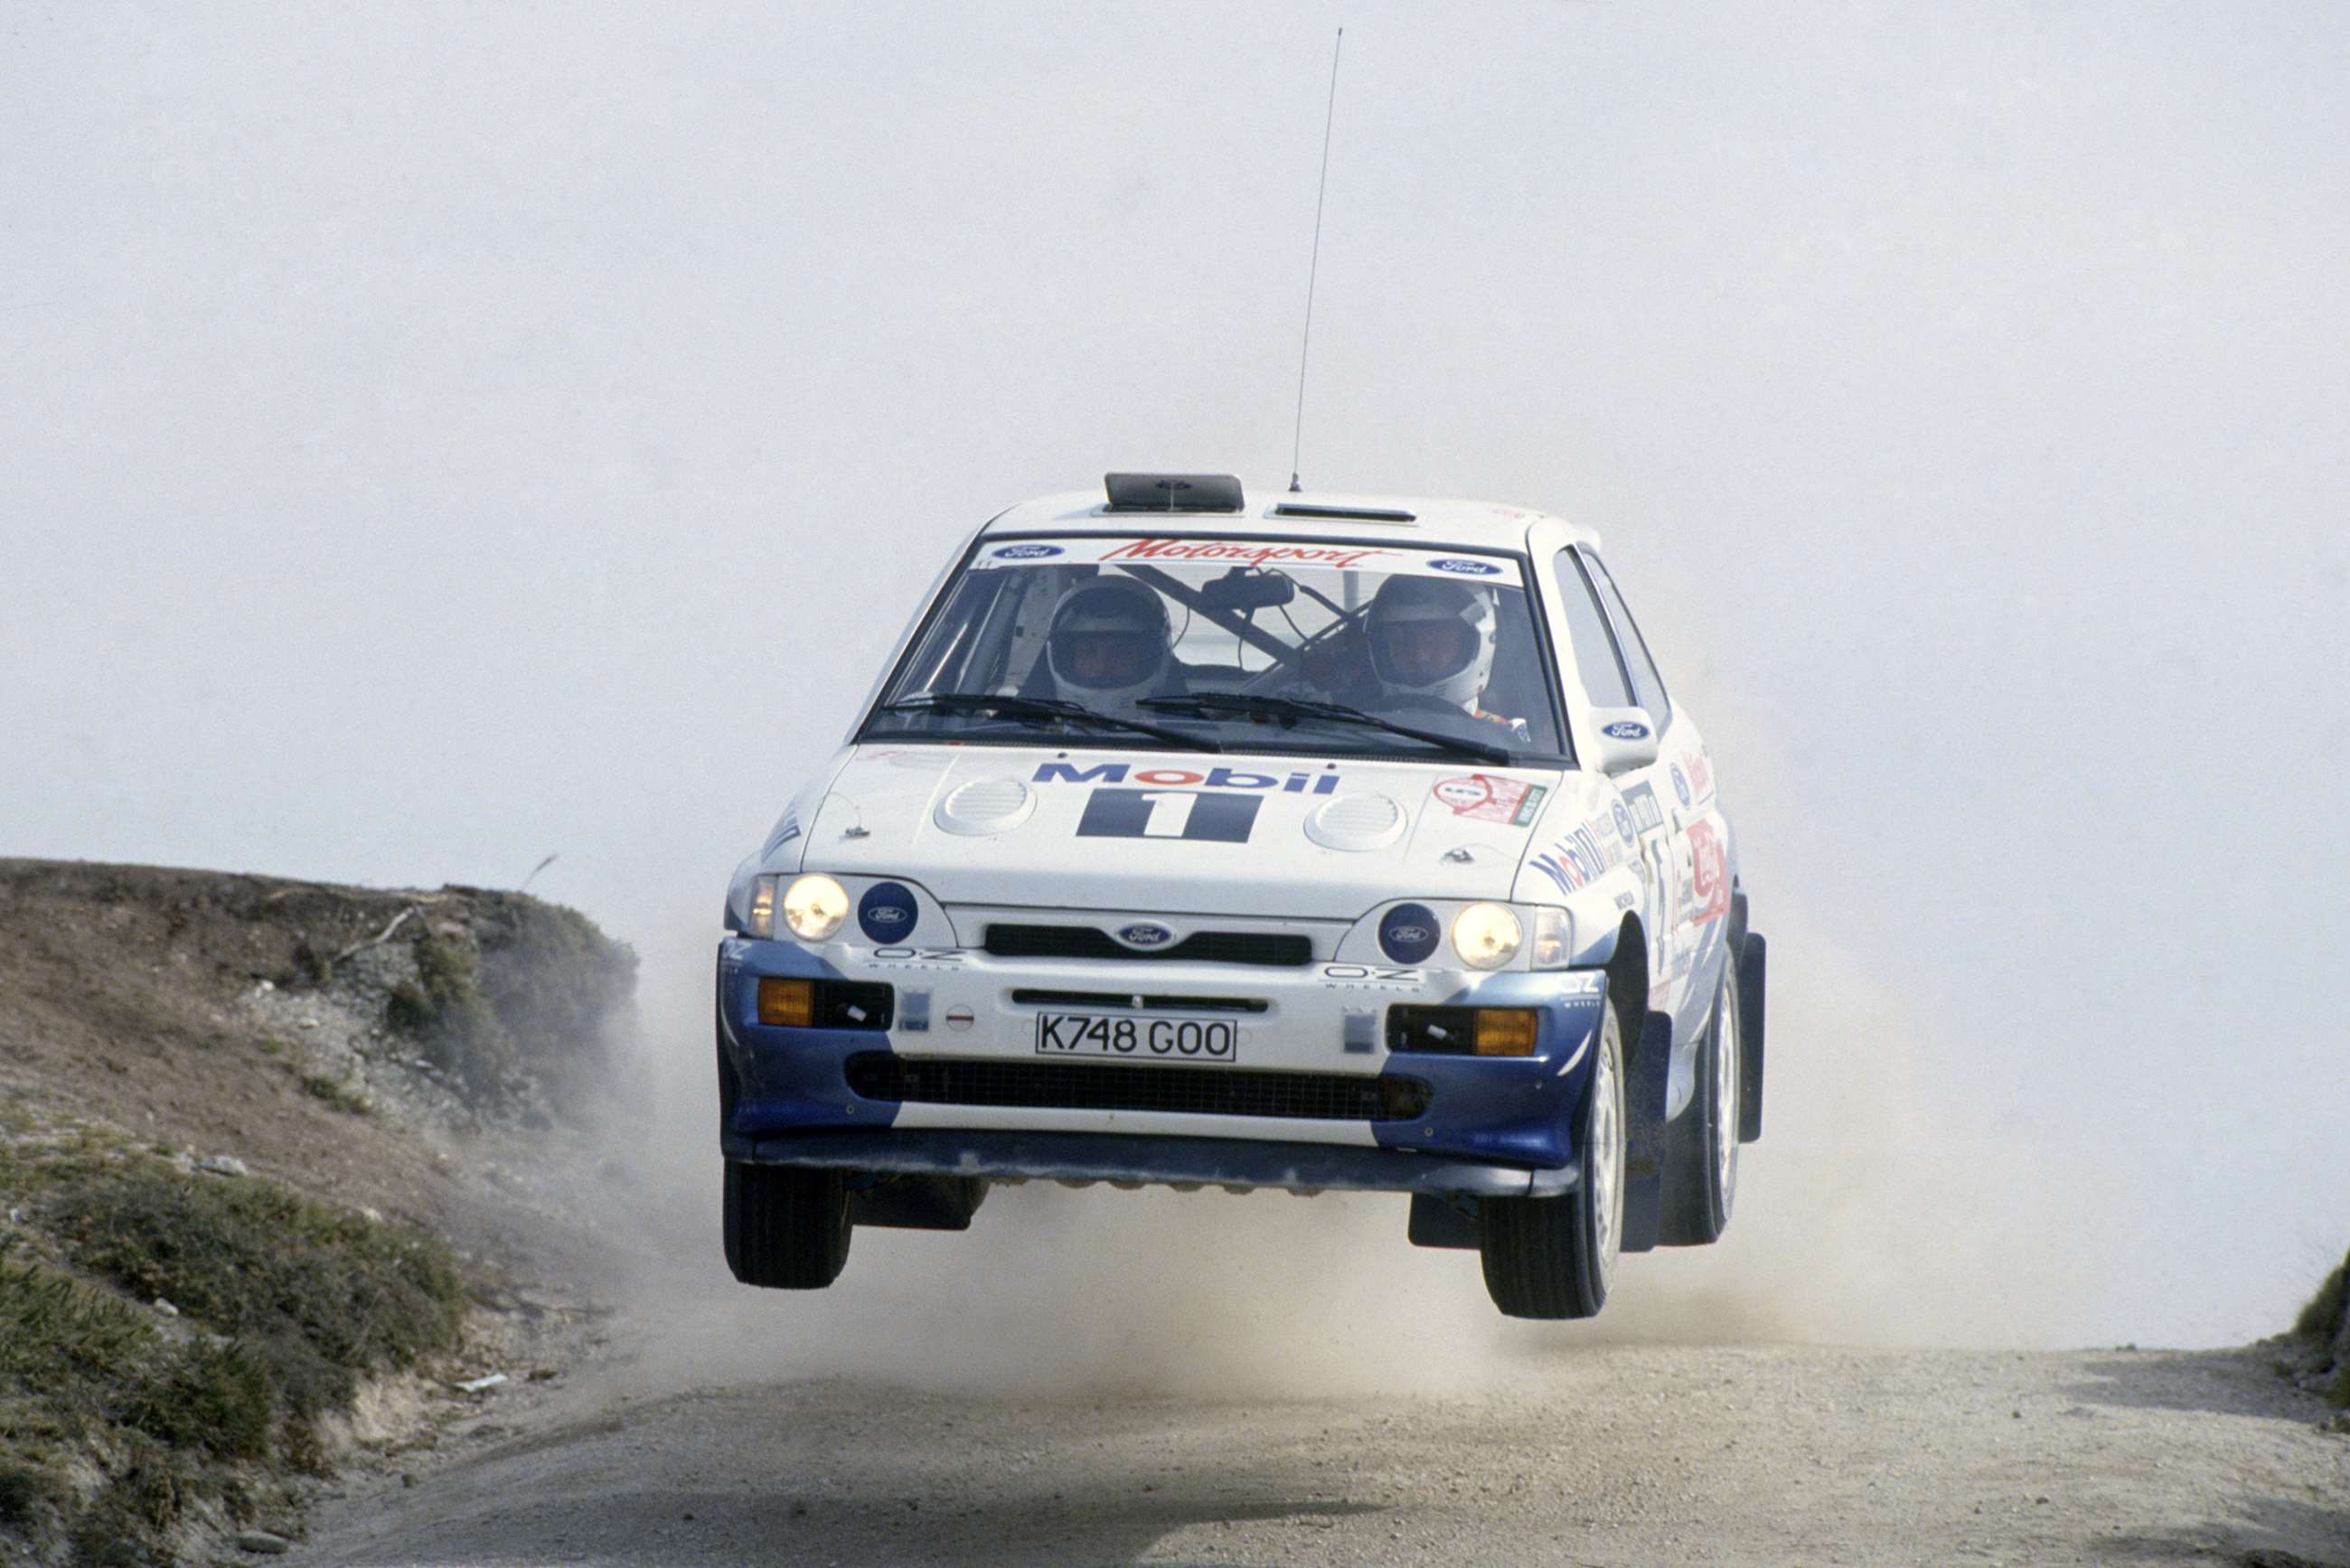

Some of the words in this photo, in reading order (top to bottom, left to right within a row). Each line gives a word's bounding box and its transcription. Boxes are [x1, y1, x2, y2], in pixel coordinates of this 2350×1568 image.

[1004, 546, 1051, 559] Ford
[1098, 538, 1403, 568] Motorsport
[1442, 559, 1488, 574] Ford
[1612, 723, 1642, 737] Ford
[1031, 763, 1340, 795] Mobil
[1141, 792, 1198, 838] 1
[874, 907, 900, 920] Ford
[1129, 926, 1161, 943] Ford
[1395, 927, 1422, 941] Ford
[1040, 1015, 1137, 1053] K748
[1148, 1020, 1231, 1056] GOO
